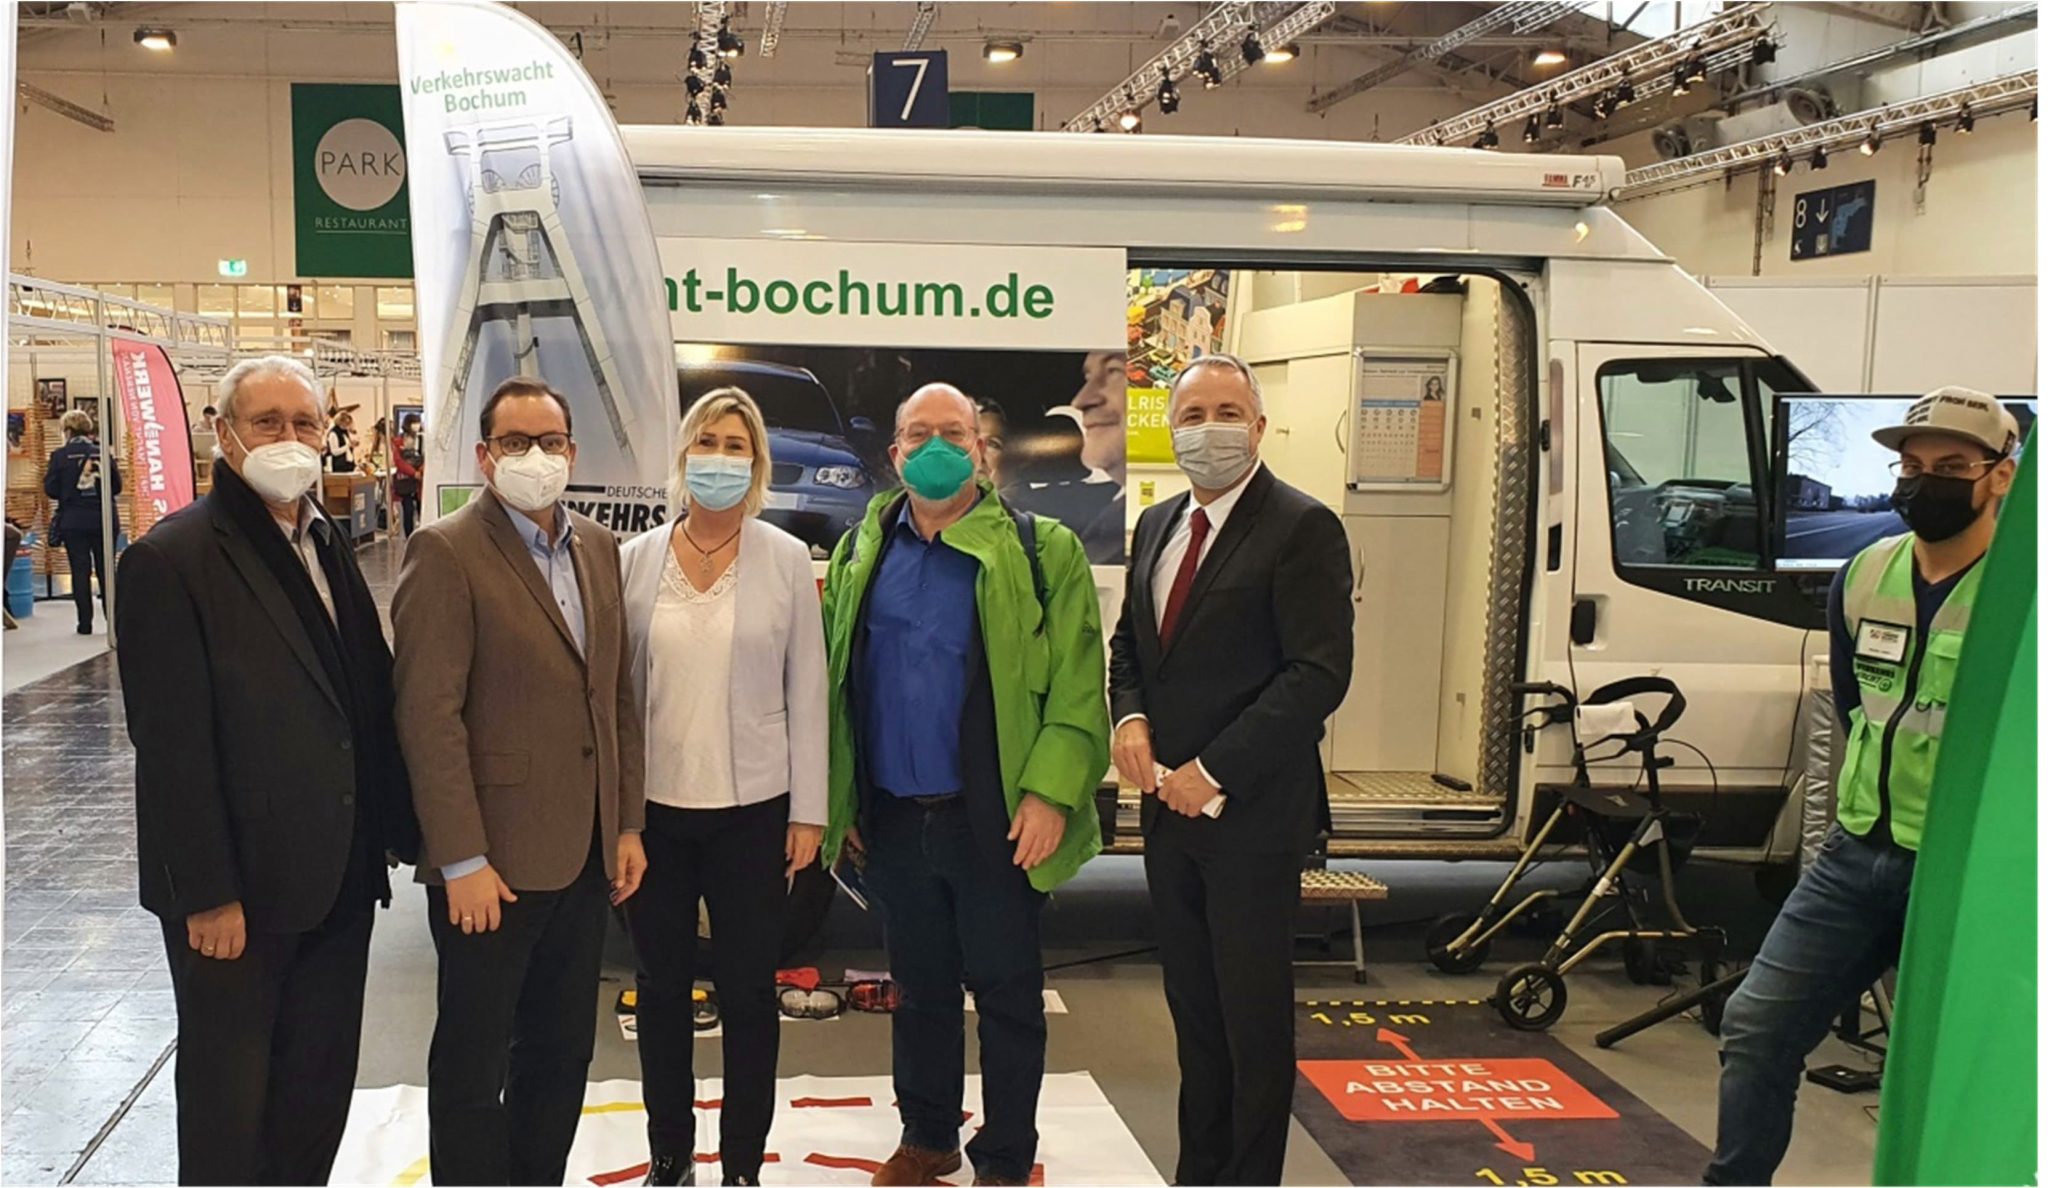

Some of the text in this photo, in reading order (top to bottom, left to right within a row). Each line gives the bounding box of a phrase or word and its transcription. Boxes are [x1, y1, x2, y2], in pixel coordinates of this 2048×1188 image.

[411, 60, 554, 95] Verkehrswacht
[892, 58, 930, 121] 7
[444, 89, 527, 114] Bochum
[320, 150, 401, 177] PARK
[1795, 198, 1808, 229] 8
[314, 216, 408, 230] RESTAURANT
[606, 486, 668, 499] DEUTSCHE
[561, 500, 667, 532] KEHRS
[1683, 577, 1777, 594] TRANSIT
[1310, 1012, 1432, 1027] 1,5 m
[1364, 1063, 1493, 1077] BITTE
[1346, 1079, 1552, 1094] ABSTAND
[1381, 1097, 1565, 1111] HALTEN
[1475, 1167, 1629, 1187] 1,5 m
